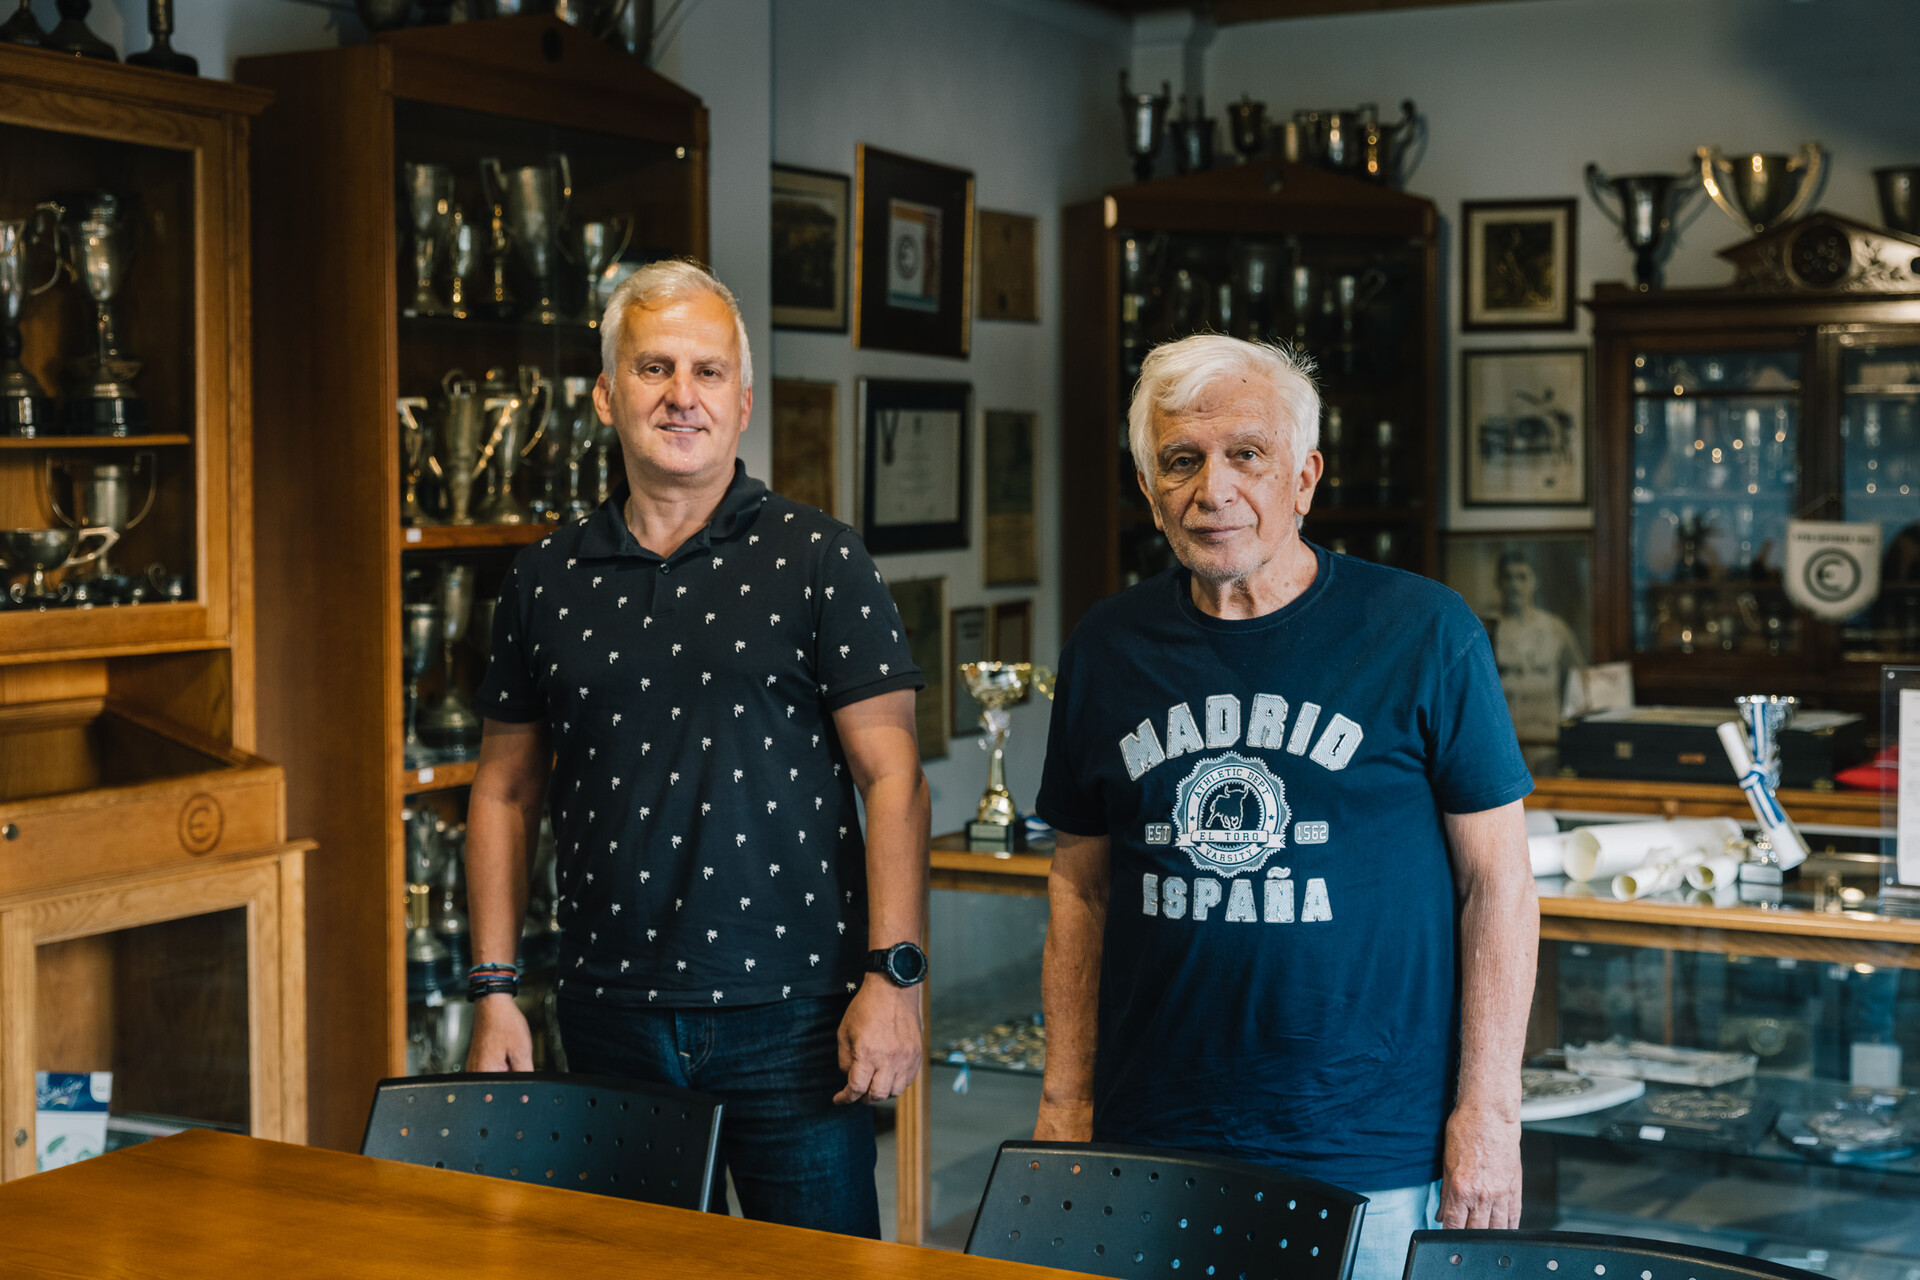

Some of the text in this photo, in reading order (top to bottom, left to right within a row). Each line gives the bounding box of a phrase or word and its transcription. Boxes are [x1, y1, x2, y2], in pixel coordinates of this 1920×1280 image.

[1119, 693, 1364, 782] MADRID
[1194, 768, 1271, 799] ATHLETIC DEPT
[1147, 825, 1170, 841] EST
[1200, 832, 1259, 841] EL TORO
[1296, 825, 1327, 840] 1562
[1205, 849, 1254, 862] VARSITY
[1142, 866, 1333, 923] ESPAÑA
